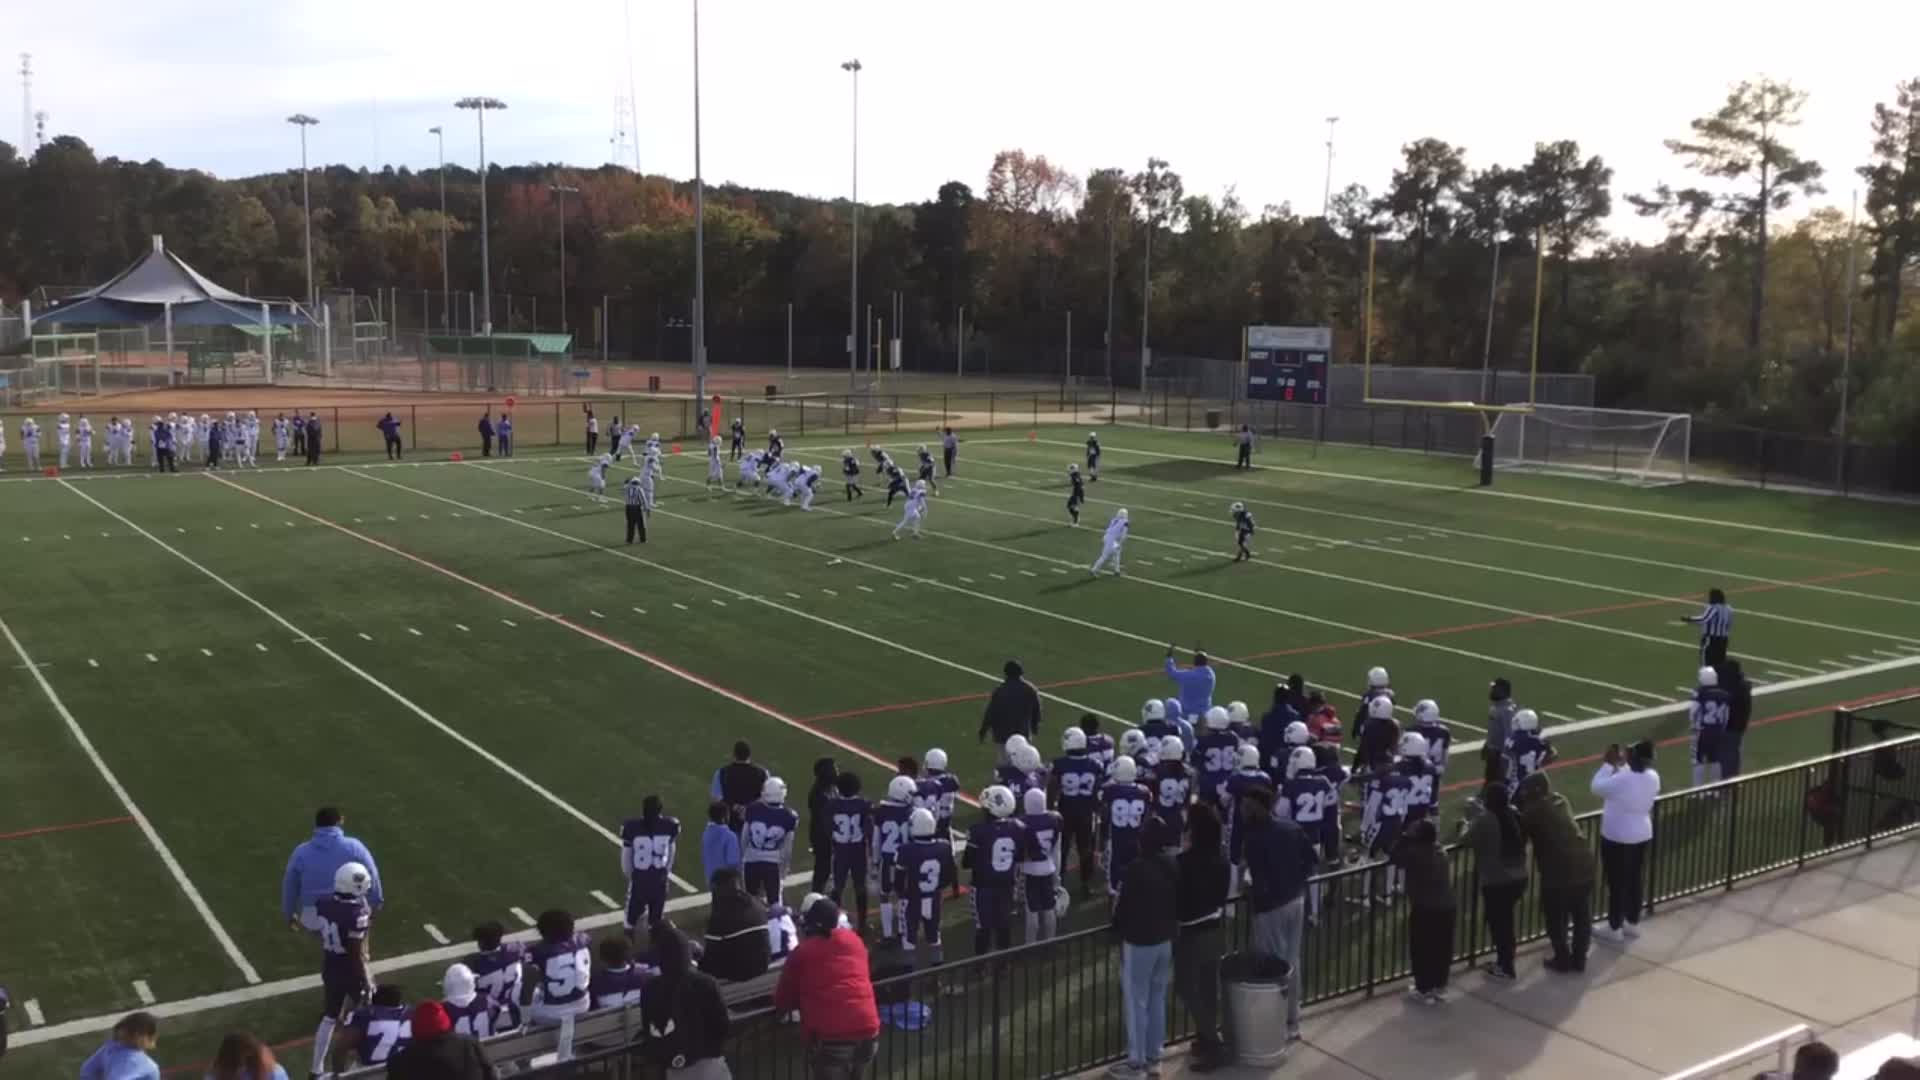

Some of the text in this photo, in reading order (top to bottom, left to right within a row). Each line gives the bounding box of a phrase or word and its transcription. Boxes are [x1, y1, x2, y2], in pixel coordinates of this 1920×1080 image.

[1296, 791, 1325, 822] 21
[832, 814, 863, 843] 31
[633, 836, 670, 869] 85
[992, 838, 1015, 871] 6
[918, 860, 940, 892] 3
